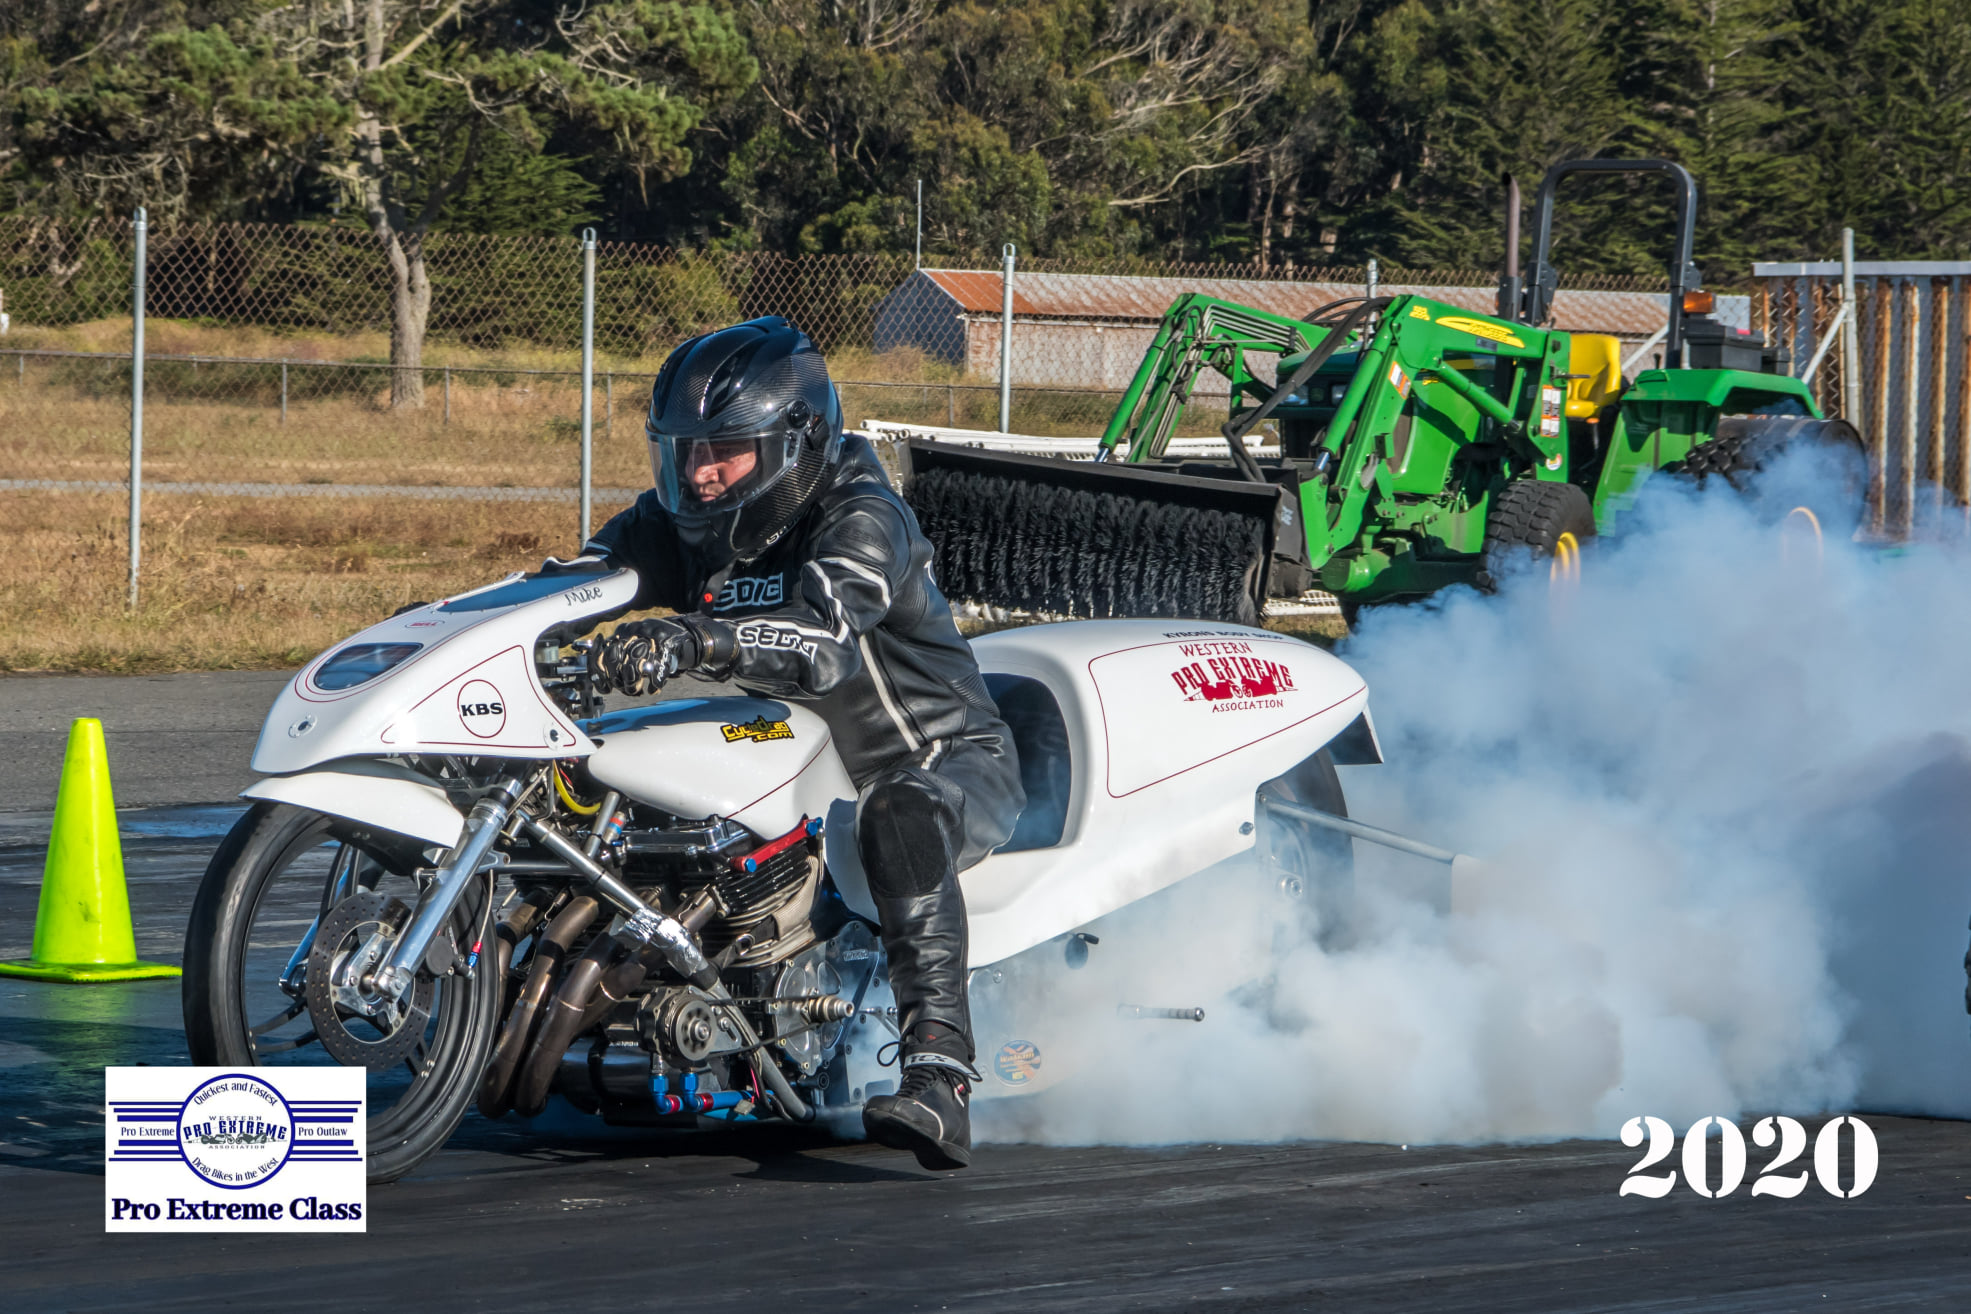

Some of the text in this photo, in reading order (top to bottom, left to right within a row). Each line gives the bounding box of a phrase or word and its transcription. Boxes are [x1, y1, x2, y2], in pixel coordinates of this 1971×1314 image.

[564, 585, 603, 606] Mike
[1179, 642, 1253, 657] WESTERN
[1171, 656, 1294, 695] PRO EXTREME
[460, 702, 504, 717] KBS
[1212, 699, 1284, 713] ASSOCIATION
